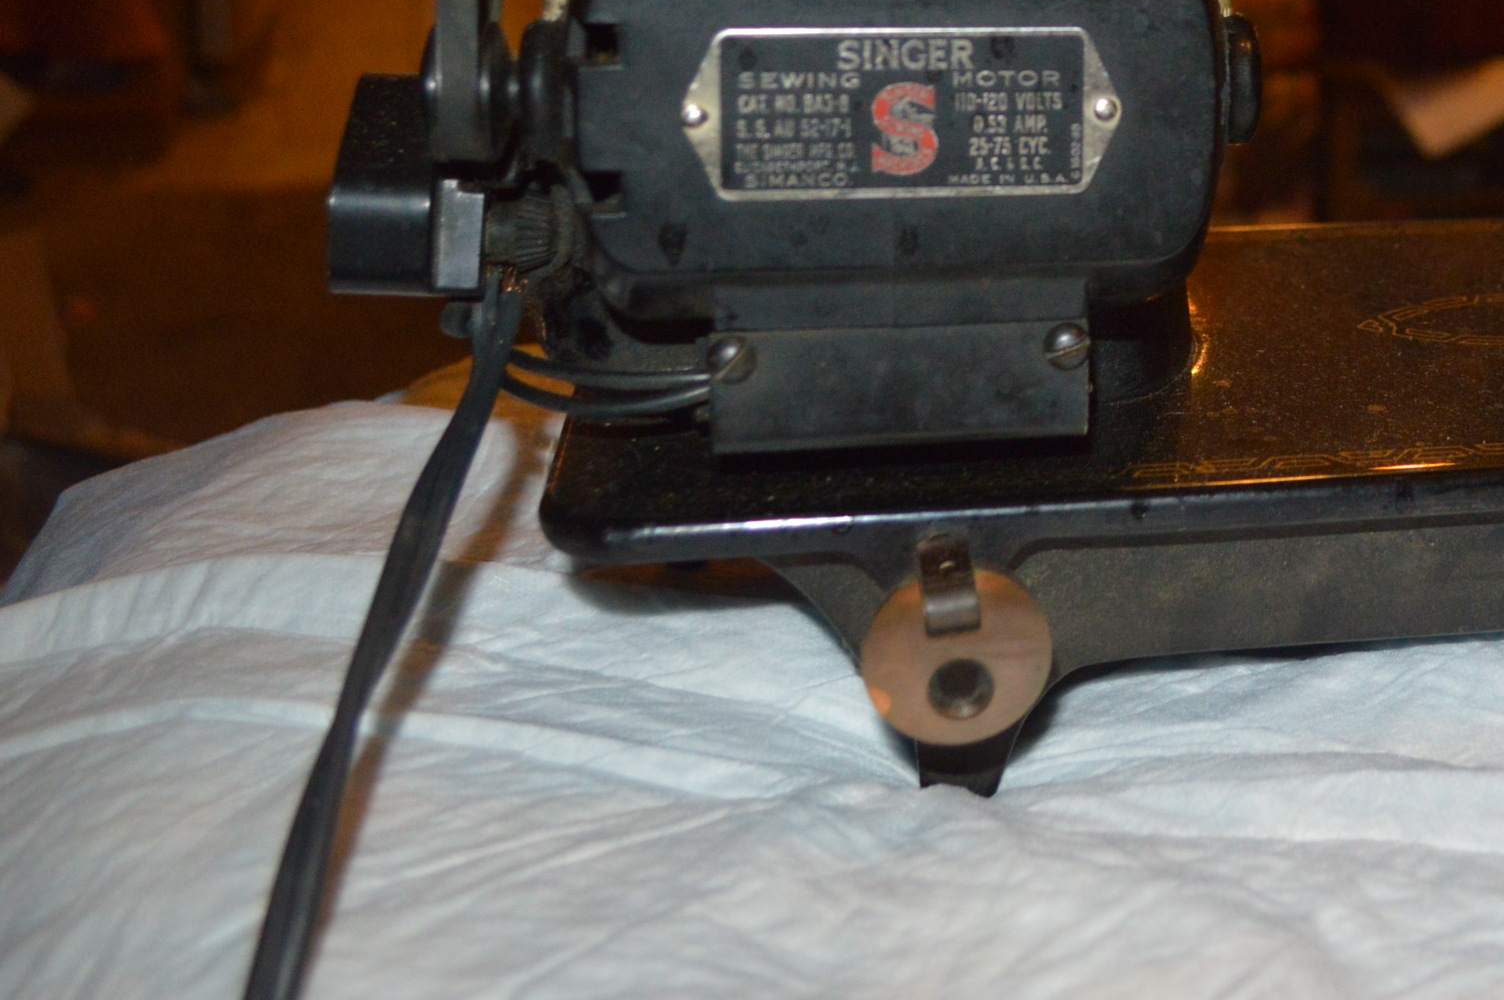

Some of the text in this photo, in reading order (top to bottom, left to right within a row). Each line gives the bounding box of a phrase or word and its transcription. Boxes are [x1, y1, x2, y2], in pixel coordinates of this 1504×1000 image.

[836, 38, 975, 71] SINGER
[737, 71, 861, 90] SEWING
[952, 69, 1061, 88] MOTOR
[955, 91, 1063, 112] 110-120 VOLTS
[1013, 113, 1049, 133] AMP.
[968, 135, 1052, 156] 25-75 CYC.
[947, 173, 992, 185] MADE
[999, 173, 1016, 184] IN
